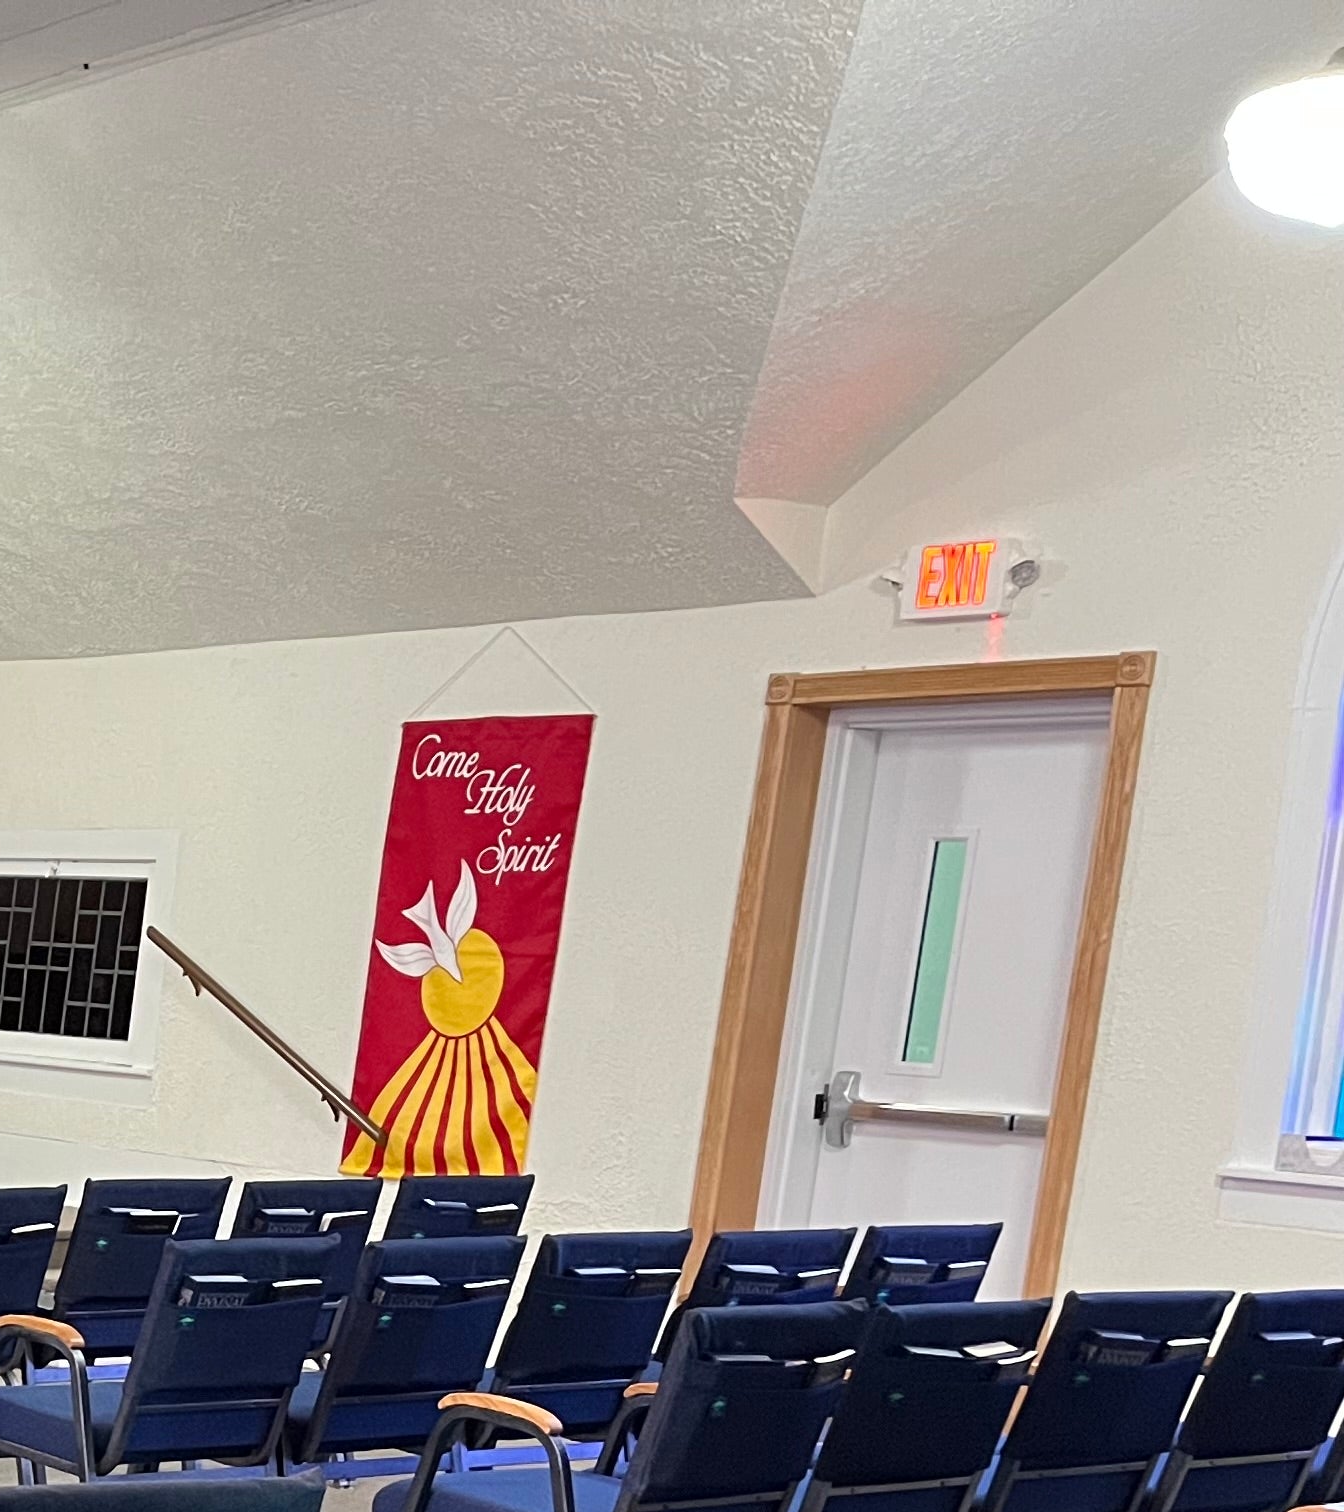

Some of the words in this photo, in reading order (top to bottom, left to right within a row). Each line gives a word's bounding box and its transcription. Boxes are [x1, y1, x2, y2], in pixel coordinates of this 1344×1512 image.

[916, 540, 997, 609] EXIT
[412, 734, 480, 779] Come
[464, 764, 536, 826] Holy
[476, 828, 561, 886] Spirit
